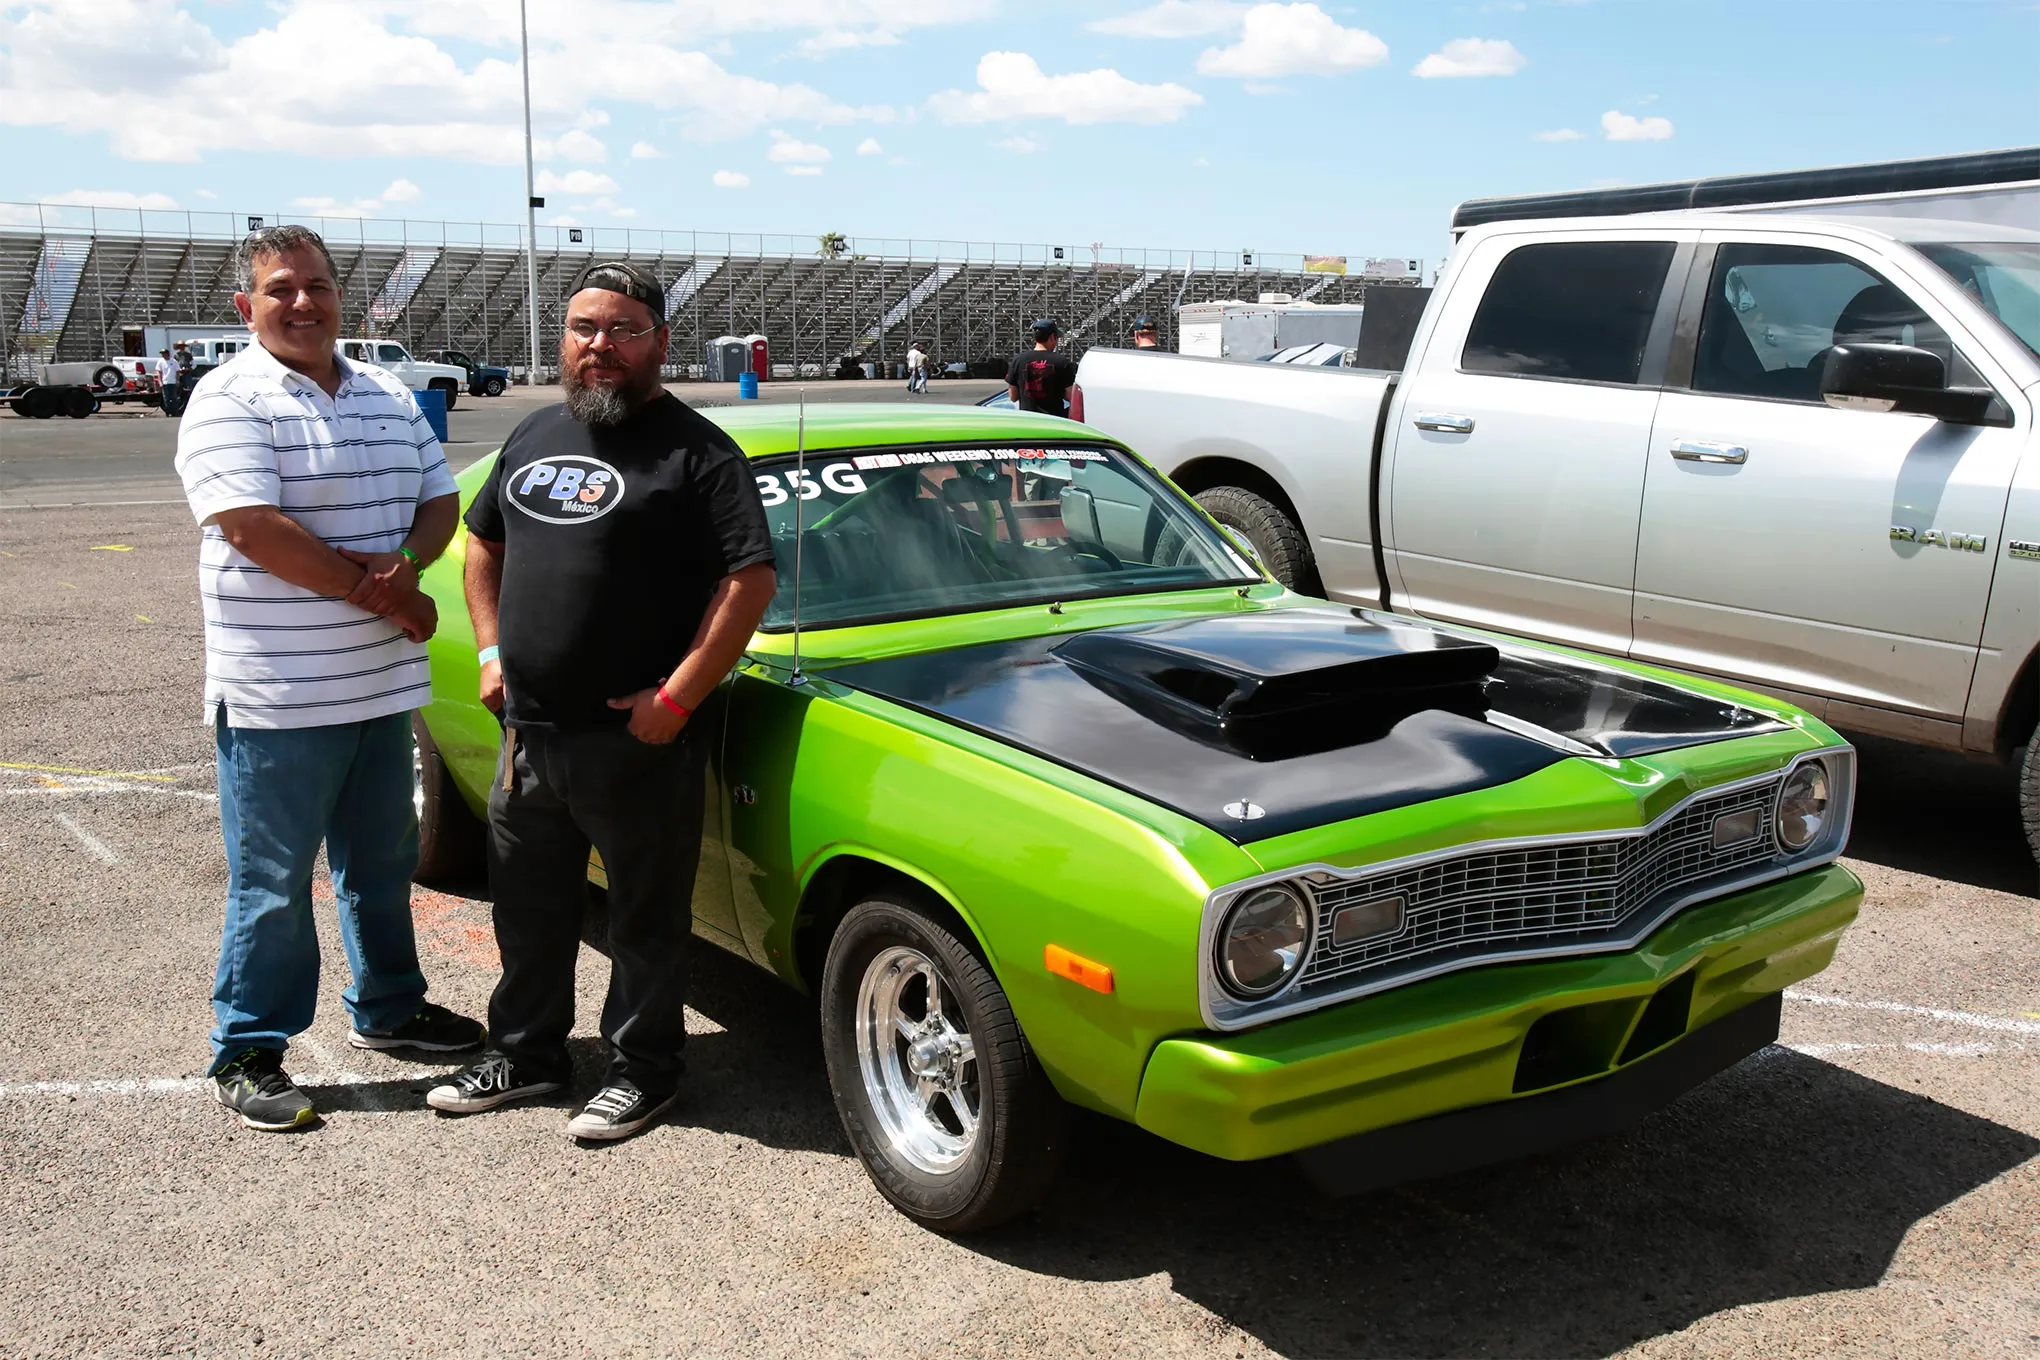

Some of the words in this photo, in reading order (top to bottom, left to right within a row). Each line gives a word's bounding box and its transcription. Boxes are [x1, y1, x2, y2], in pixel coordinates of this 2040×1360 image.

[249, 218, 263, 230] P20
[570, 231, 582, 241] P19
[898, 452, 936, 465] DRAG
[932, 448, 993, 463] WEEKEND
[989, 448, 1020, 460] 2016
[519, 464, 611, 502] PBS
[755, 463, 868, 507] 35G
[561, 500, 599, 514] México
[1889, 526, 1986, 552] RAM
[2009, 539, 2040, 552] HE
